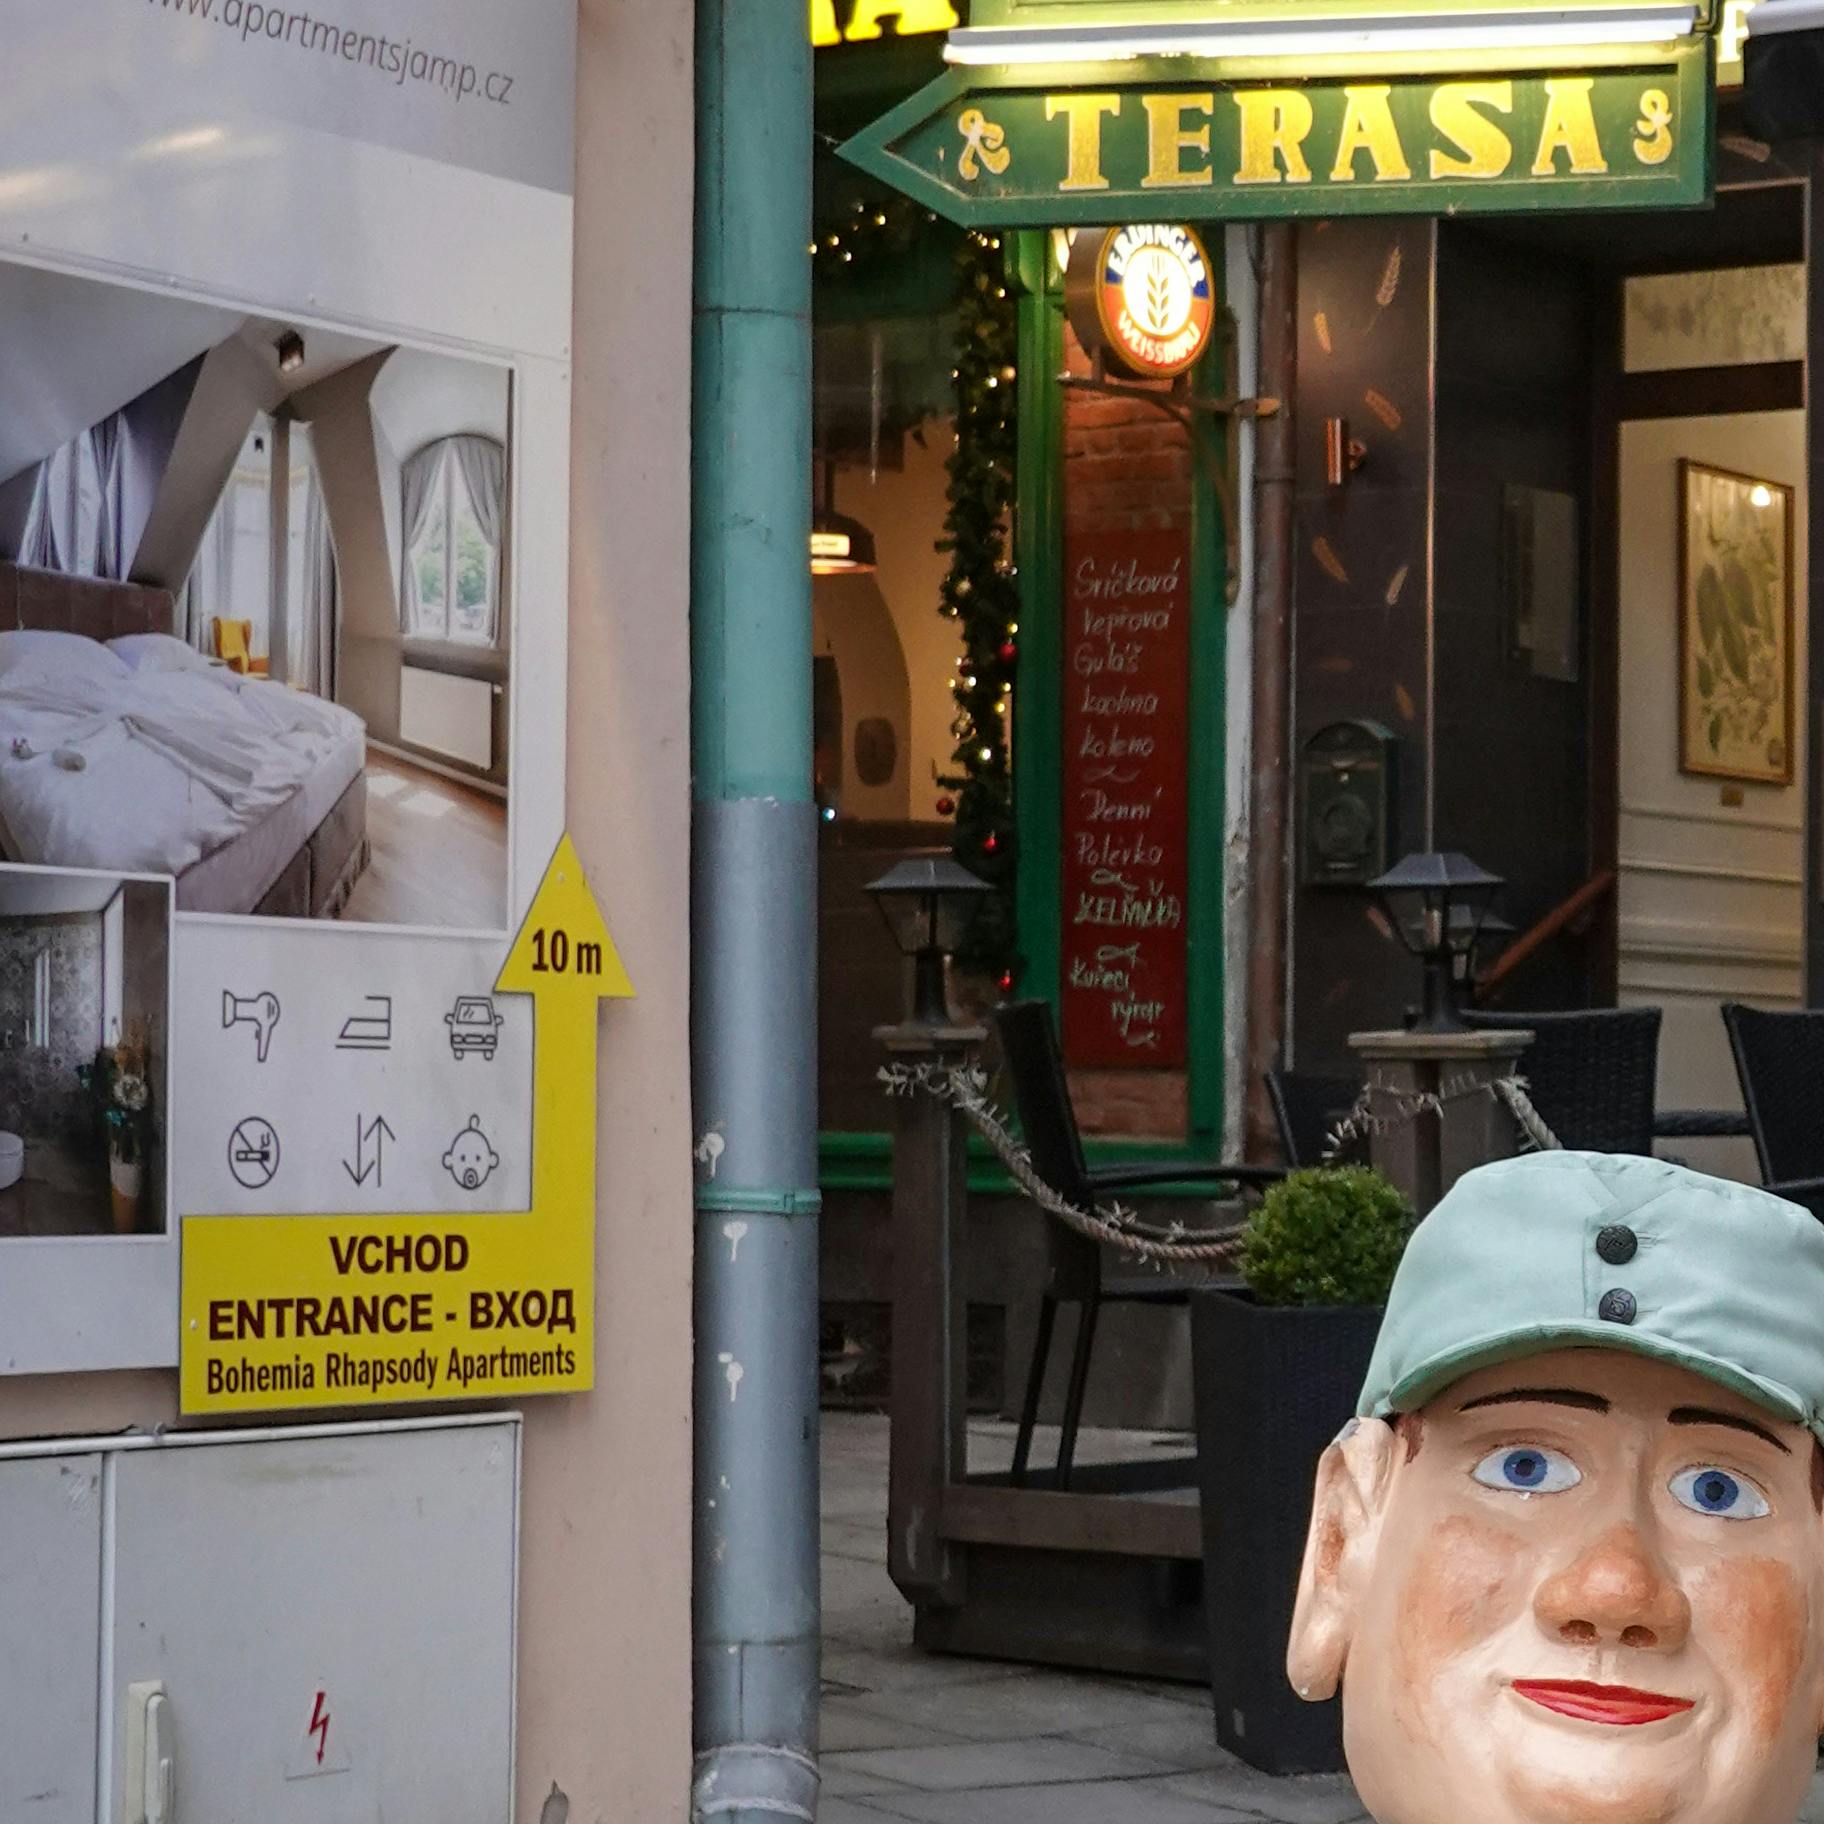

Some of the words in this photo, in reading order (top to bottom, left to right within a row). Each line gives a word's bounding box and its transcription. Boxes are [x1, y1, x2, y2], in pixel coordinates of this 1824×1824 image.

[1045, 78, 1608, 191] TERASA
[1108, 224, 1206, 288] ERDINGER
[532, 928, 569, 973] 10
[577, 941, 602, 974] m
[329, 1234, 469, 1275] VCHOD
[208, 1293, 434, 1341] ENTRANCE
[470, 1289, 576, 1334] ВХОД
[207, 1353, 315, 1395] Bohemia
[326, 1348, 438, 1393] Rhapsody
[446, 1343, 576, 1388] Apartments
